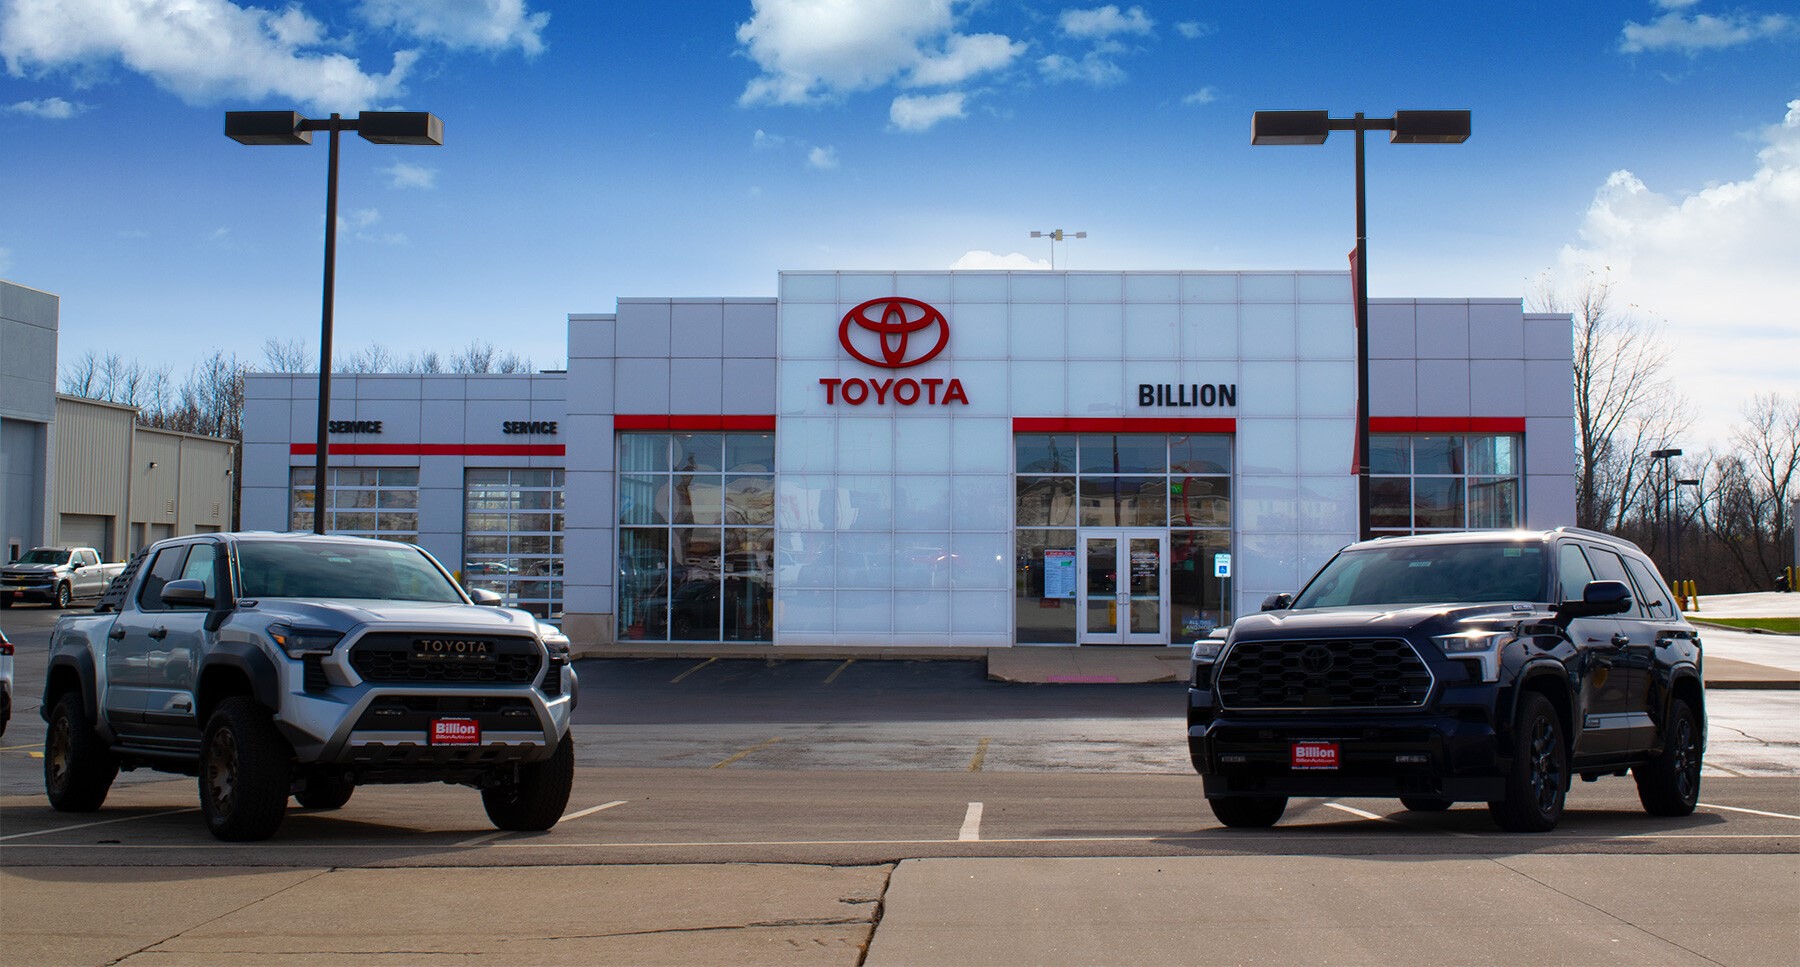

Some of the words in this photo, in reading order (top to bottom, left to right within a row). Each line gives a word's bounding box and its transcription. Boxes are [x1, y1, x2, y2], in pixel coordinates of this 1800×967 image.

[819, 377, 969, 406] TOYOTA
[1138, 383, 1237, 407] BILLION
[328, 420, 383, 434] SERVICE
[502, 421, 558, 435] SERVICE
[422, 640, 486, 652] TOYOTA
[435, 722, 476, 734] Billion
[1295, 746, 1335, 757] Billion
